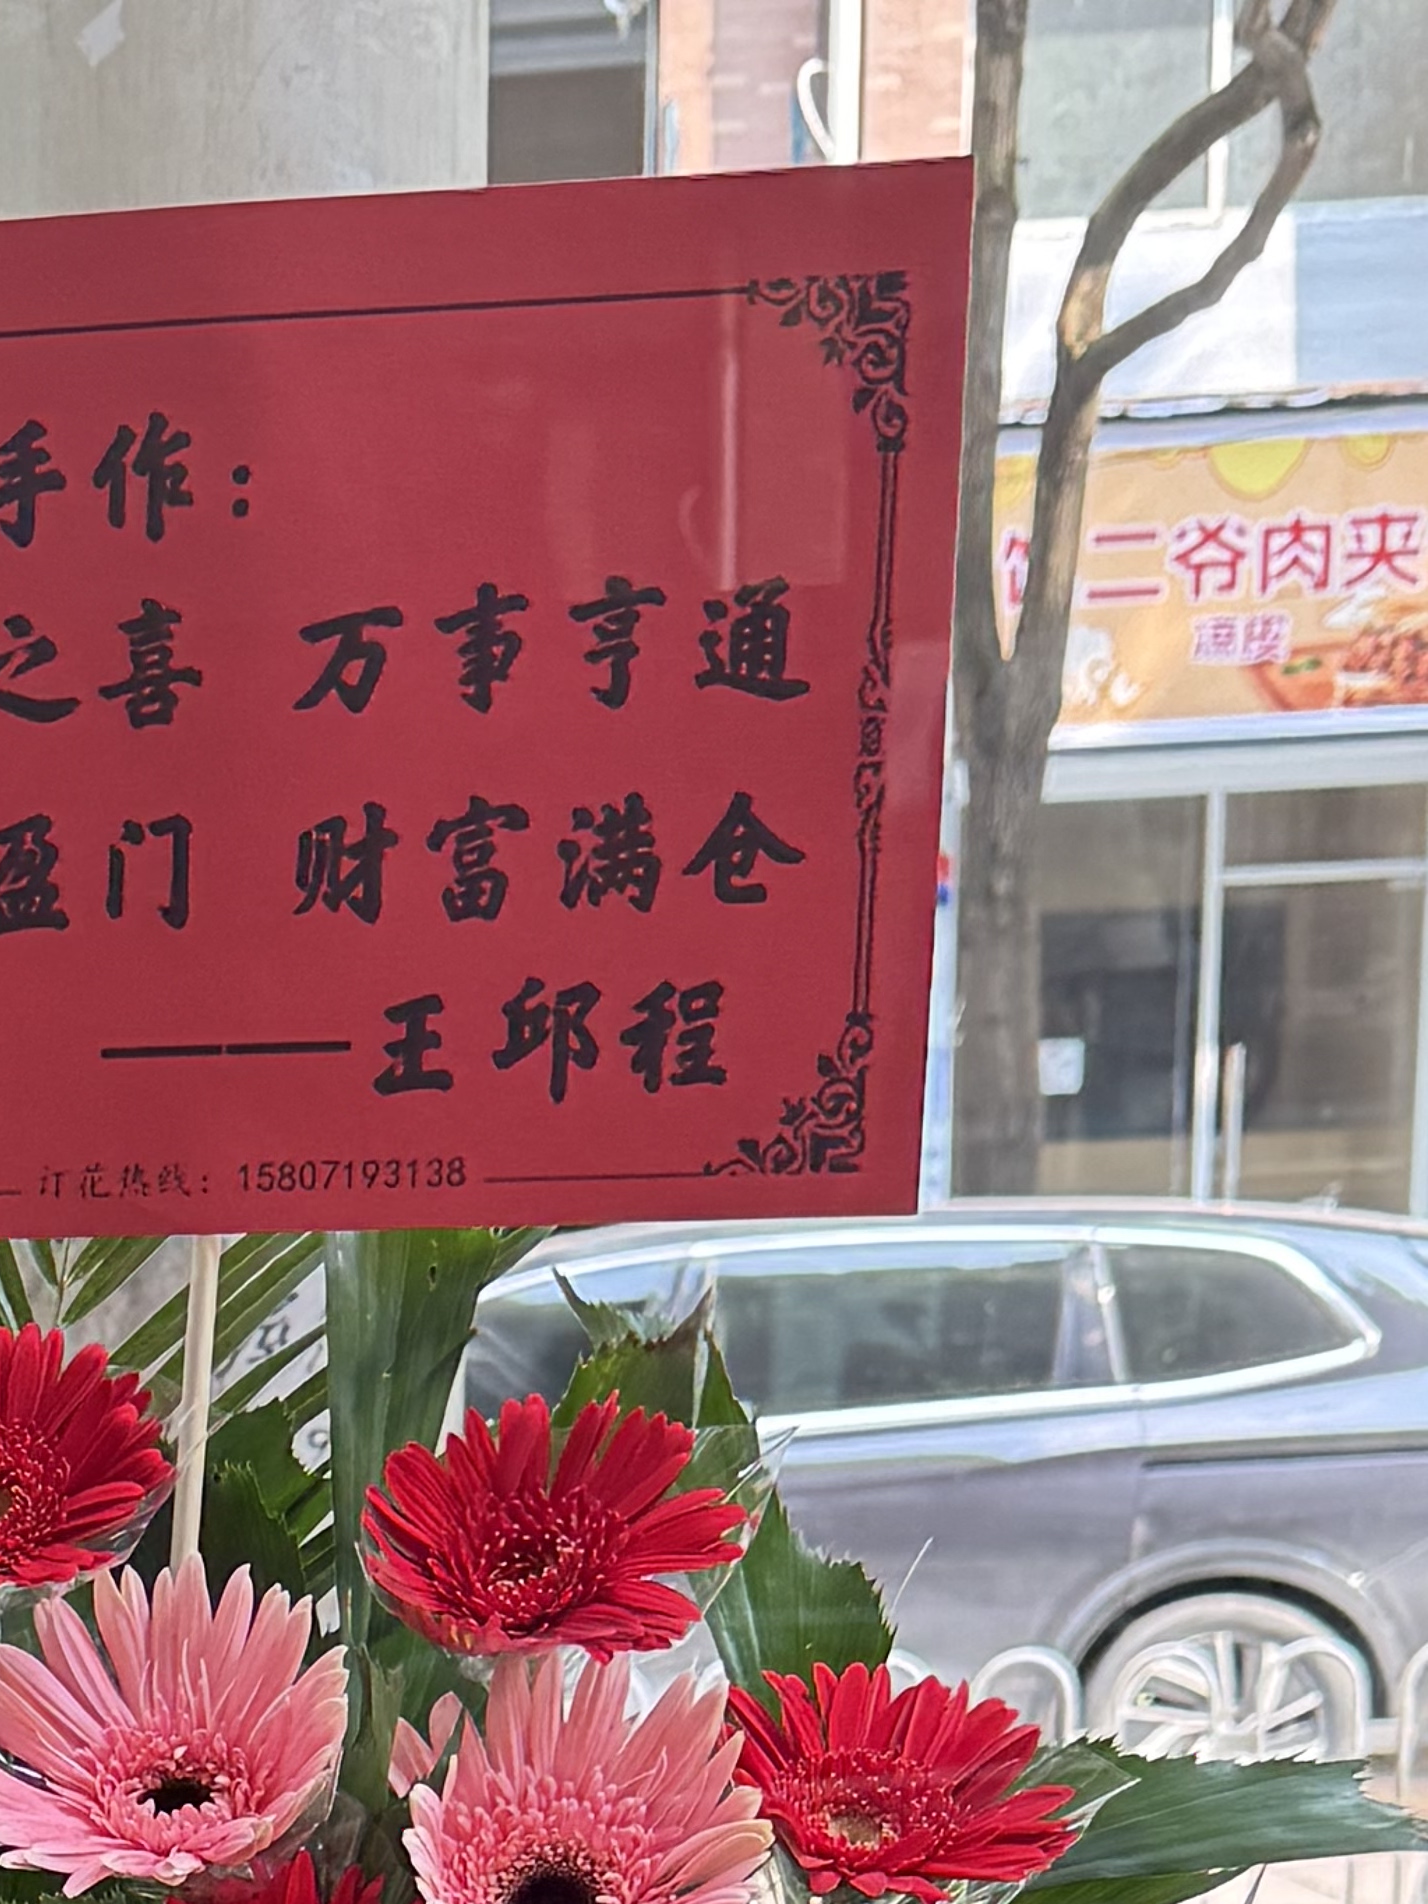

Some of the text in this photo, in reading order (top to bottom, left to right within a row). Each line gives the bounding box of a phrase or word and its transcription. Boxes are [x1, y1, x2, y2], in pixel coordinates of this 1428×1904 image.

[1005, 512, 1421, 604] 二爷肉夹
[292, 575, 811, 716] 万事亨通
[292, 791, 806, 925] 财富满仓
[237, 1156, 467, 1194] 15807193138
